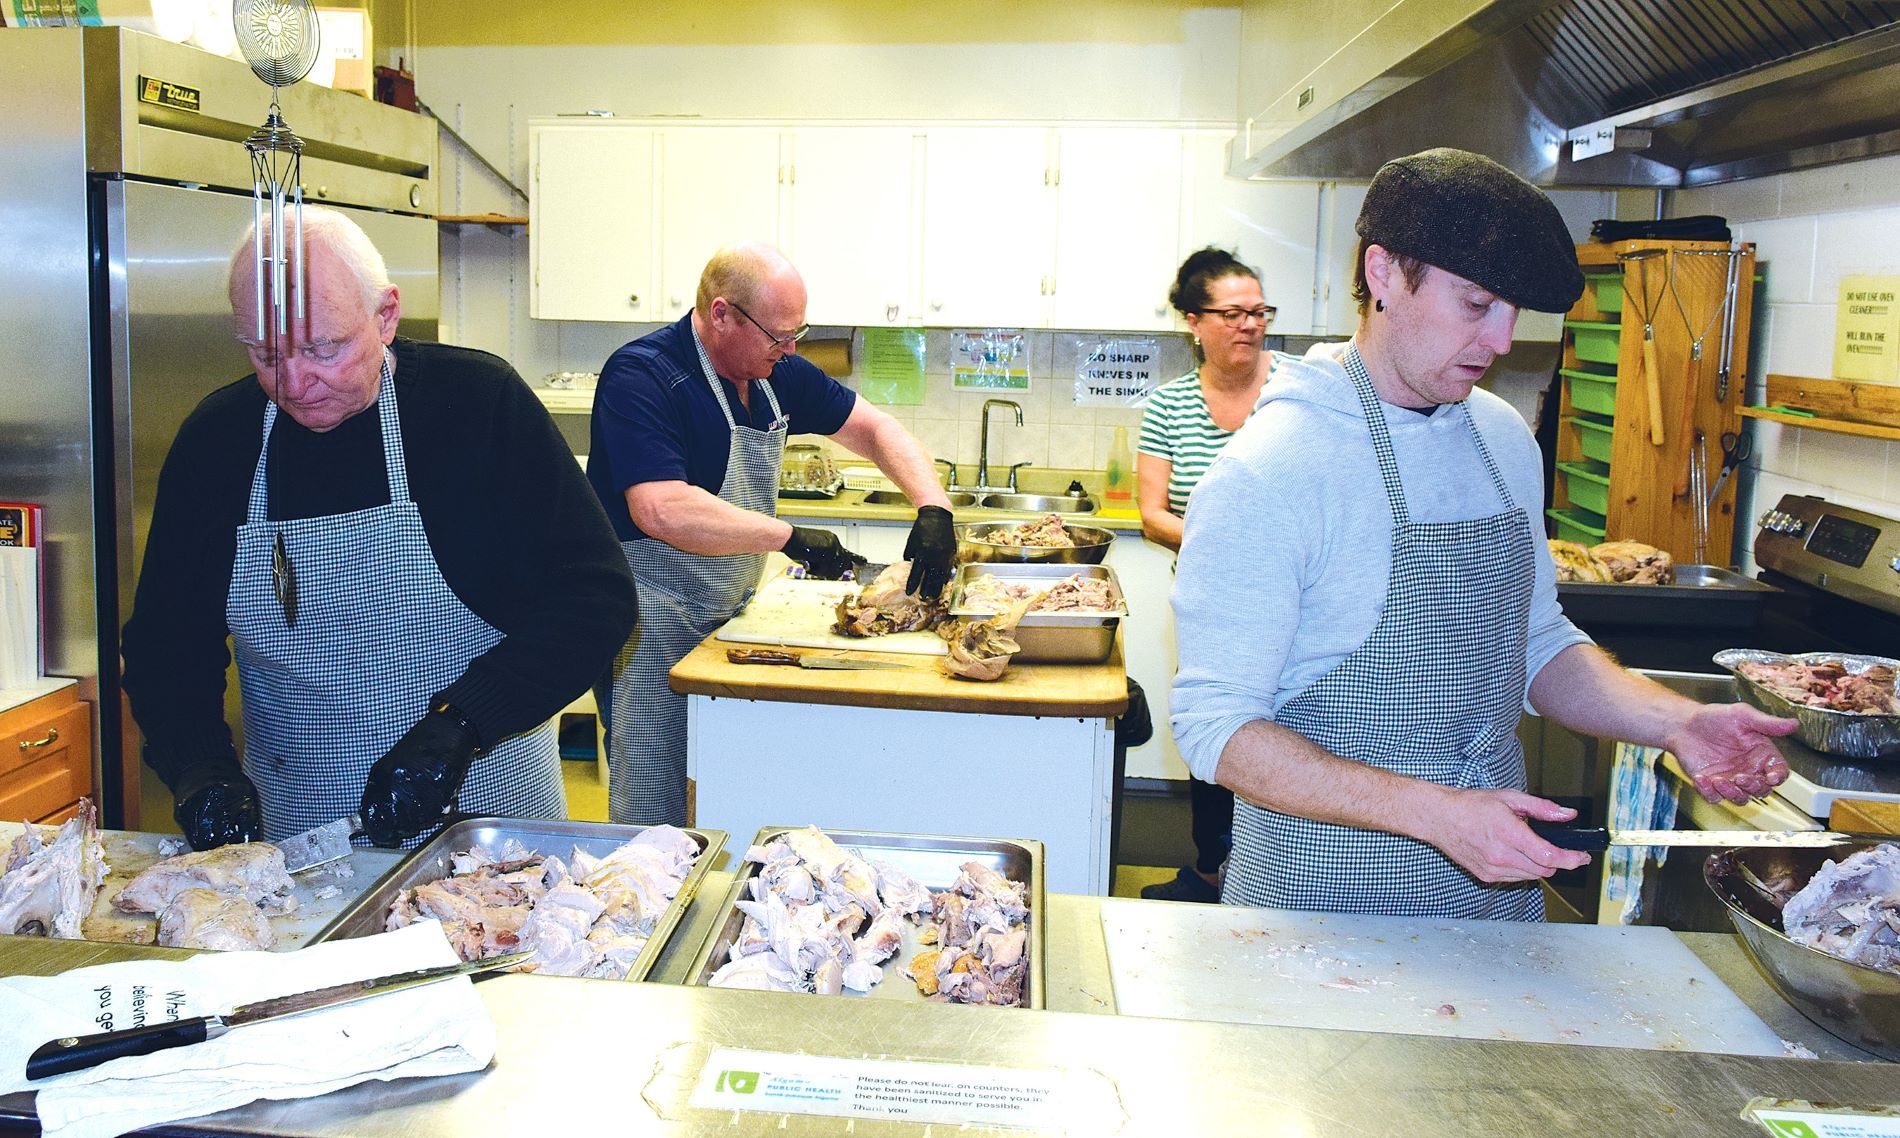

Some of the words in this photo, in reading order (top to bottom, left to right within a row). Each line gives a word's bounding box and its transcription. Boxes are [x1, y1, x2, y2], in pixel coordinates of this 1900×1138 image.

[1879, 292, 1895, 302] OVEN
[1109, 353, 1150, 363] SHARP
[1136, 371, 1149, 380] IN
[1088, 387, 1112, 396] THE
[93, 984, 112, 1009] you
[95, 1012, 115, 1032] ge
[767, 1084, 802, 1092] PUBLIC
[805, 1086, 842, 1094] HEALTH
[858, 1076, 892, 1085] Please
[973, 1084, 1023, 1093] counters,
[856, 1085, 881, 1093] have
[885, 1086, 911, 1094] been
[914, 1088, 961, 1098] sanitized
[875, 1094, 928, 1104] healthiest
[931, 1098, 973, 1107] manner
[976, 1102, 1024, 1110] possible.
